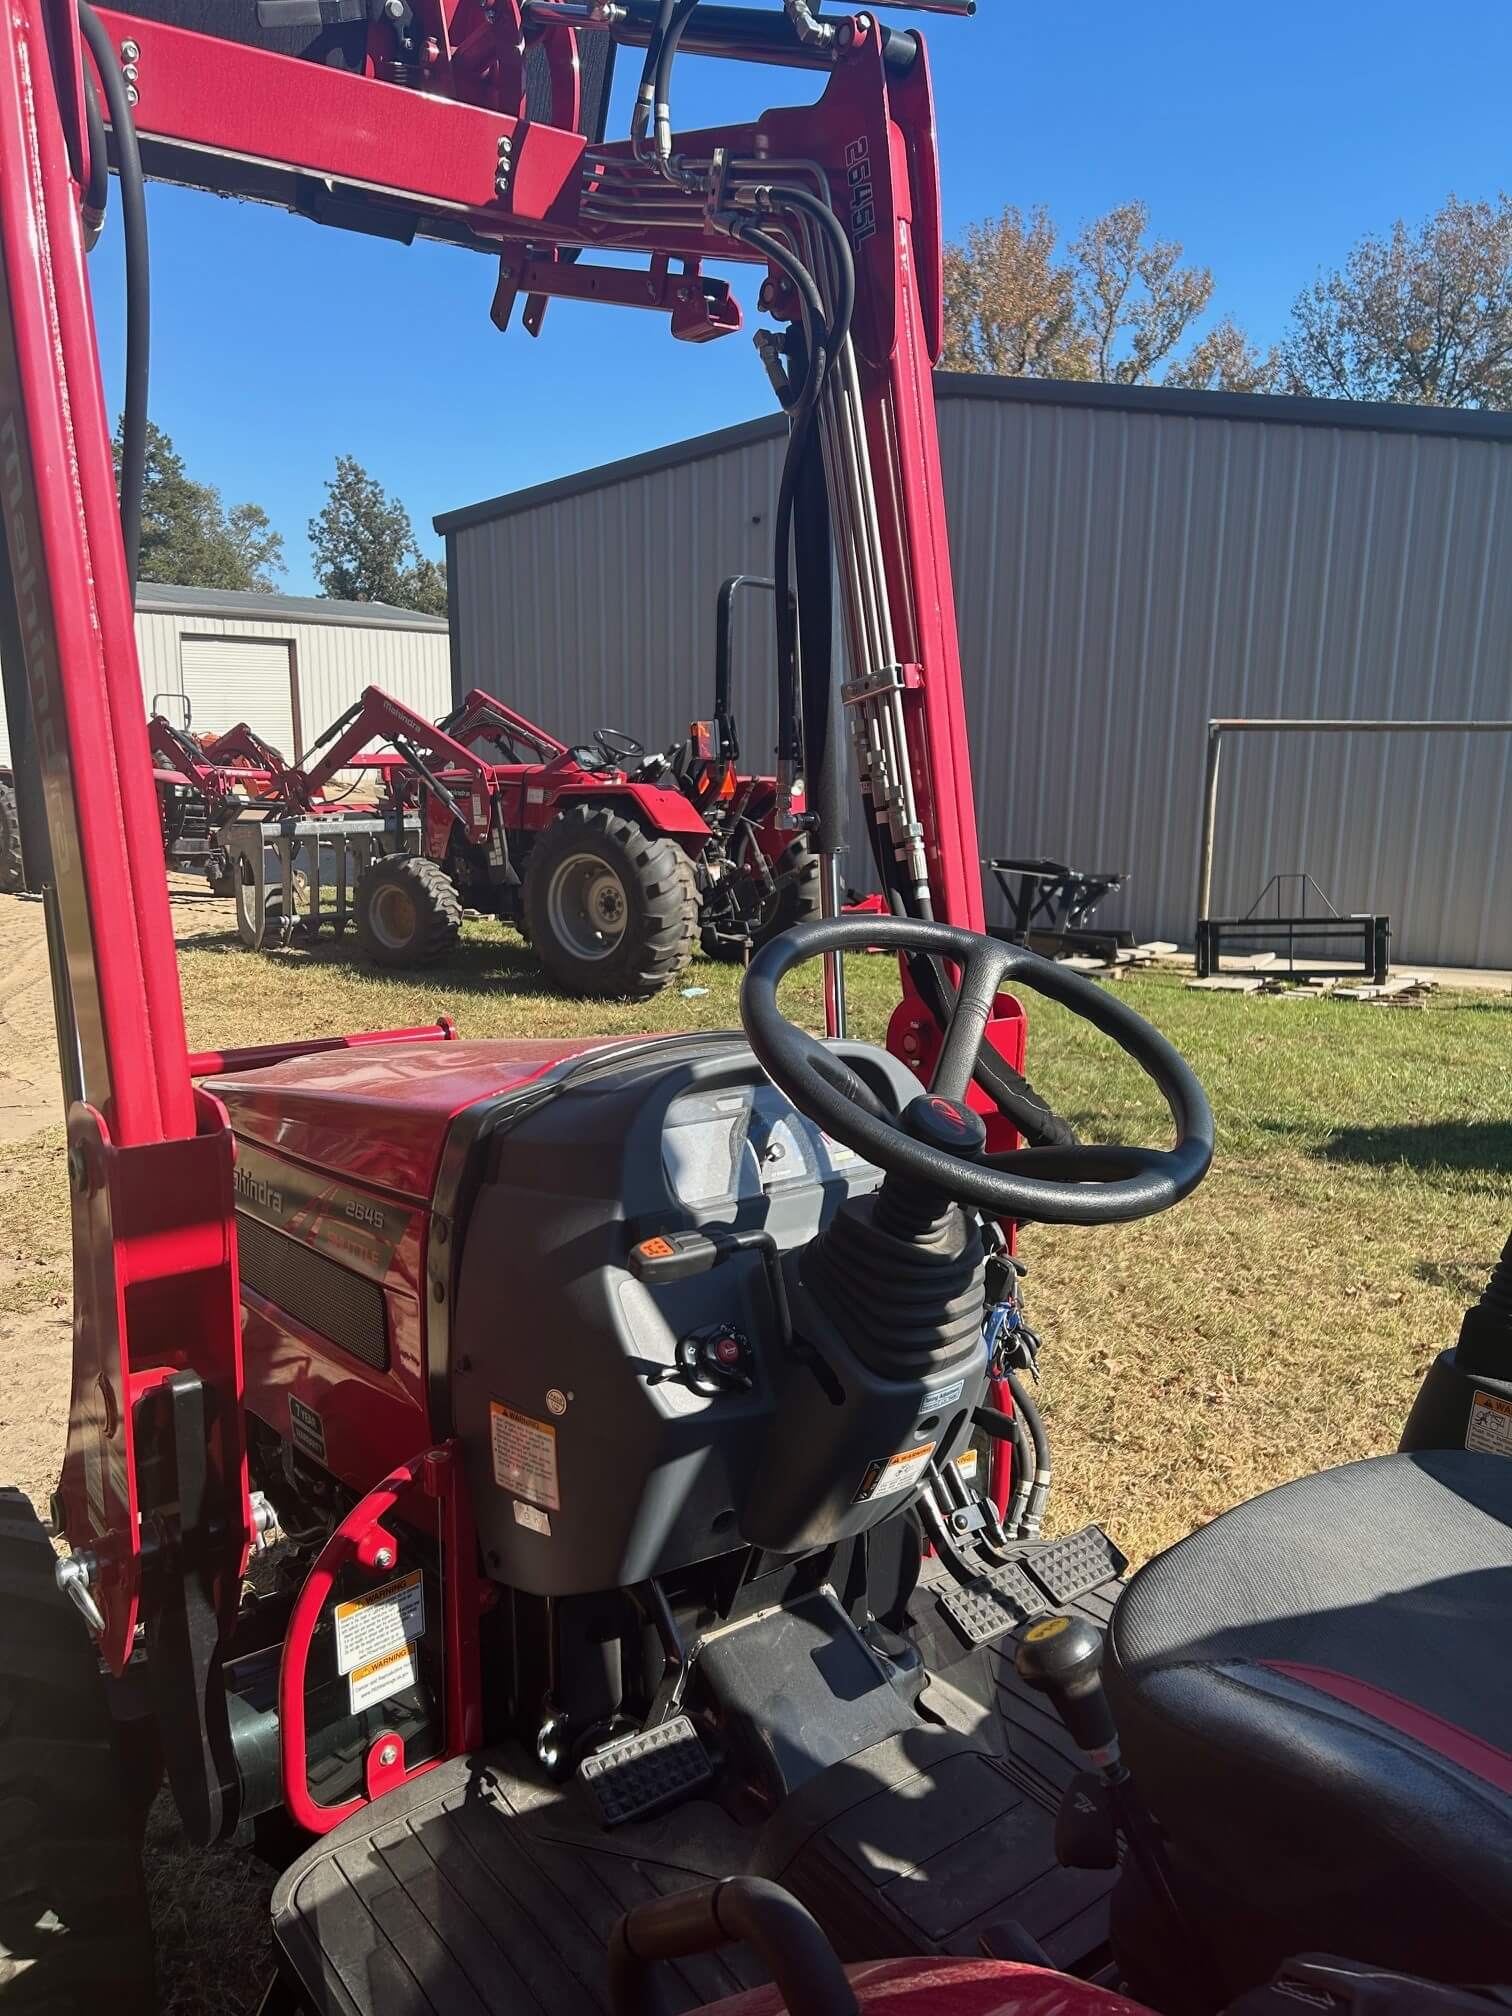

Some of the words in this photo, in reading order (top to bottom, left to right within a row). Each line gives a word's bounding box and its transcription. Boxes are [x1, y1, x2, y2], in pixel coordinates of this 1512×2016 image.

[844, 135, 878, 252] 2645L
[233, 1168, 283, 1214] ahindra
[346, 1200, 384, 1228] 2645
[366, 1581, 407, 1605] WARNING
[371, 1650, 407, 1671] WARNING
